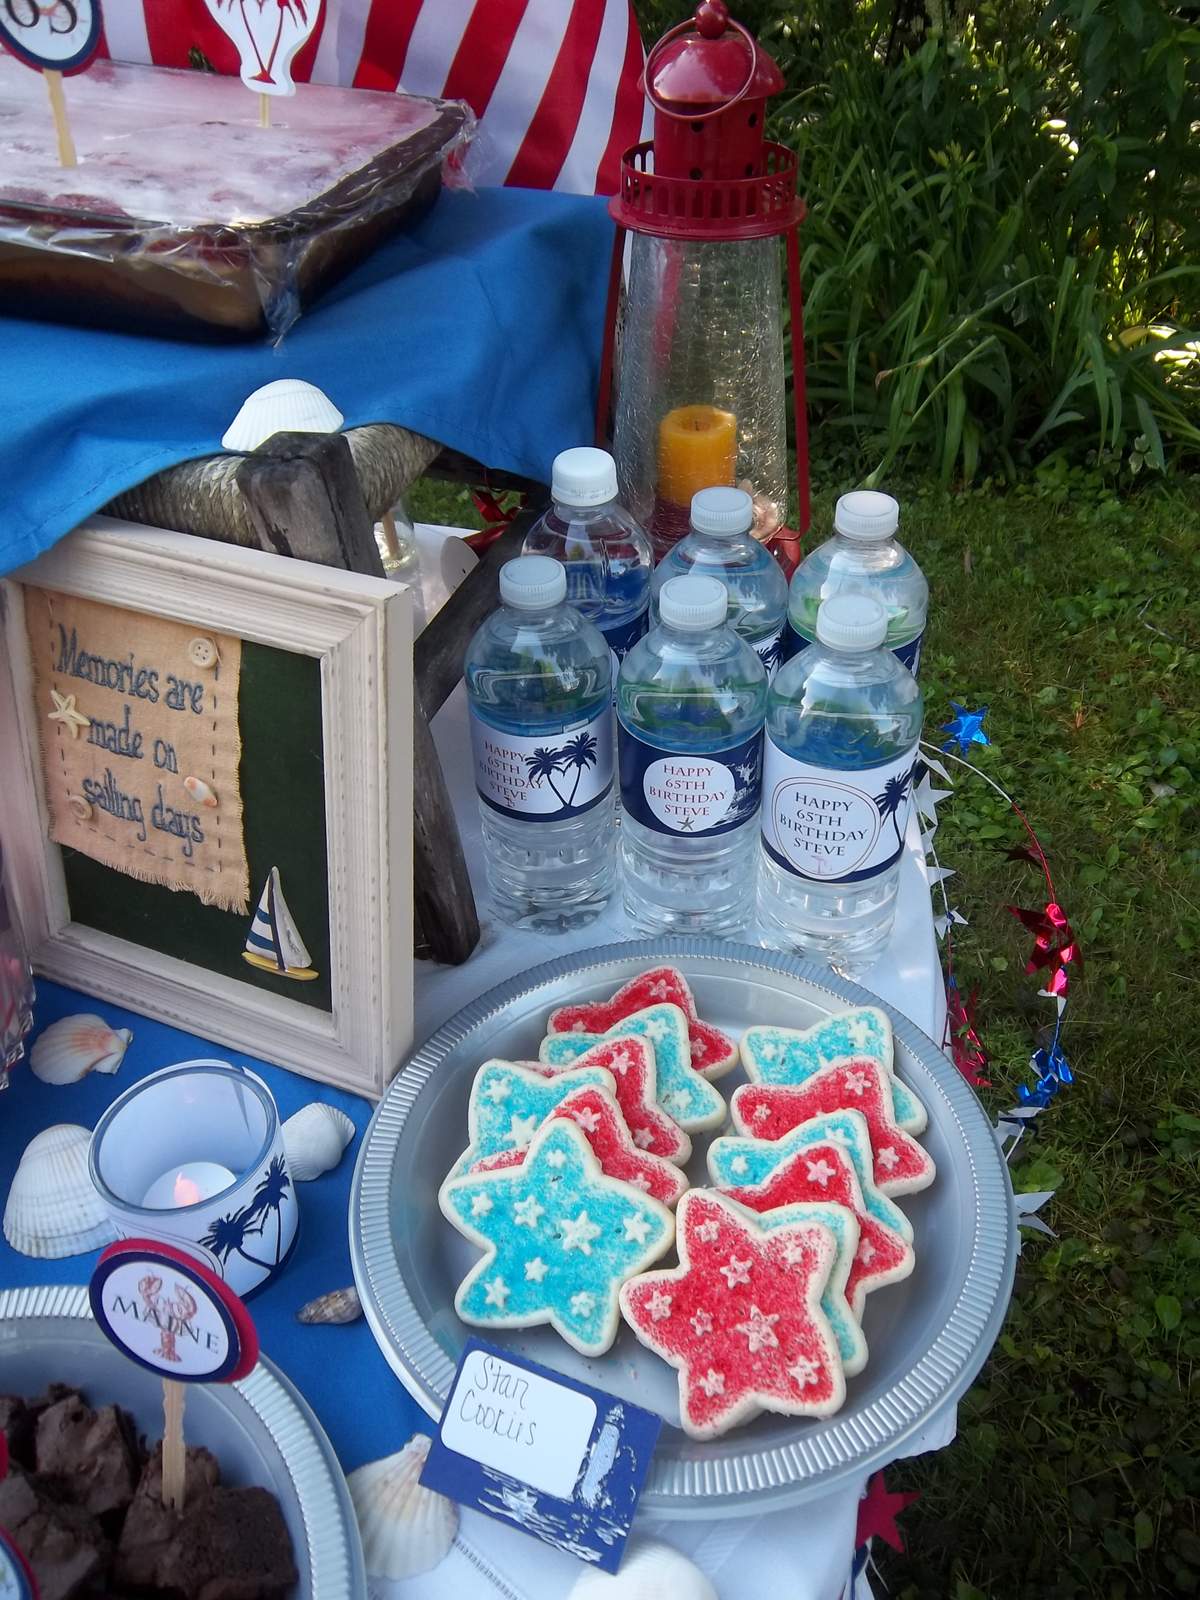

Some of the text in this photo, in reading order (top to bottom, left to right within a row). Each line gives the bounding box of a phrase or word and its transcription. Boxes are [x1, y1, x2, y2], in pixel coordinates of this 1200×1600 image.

[54, 622, 204, 715] Memories are
[86, 704, 178, 775] made on
[484, 740, 526, 762] HAPPY
[488, 756, 520, 775] 65TH
[663, 764, 714, 777] HAPPY
[490, 781, 527, 801] STEVE
[665, 779, 705, 790] 65TH
[649, 786, 727, 804] BIRTHDAY
[795, 791, 853, 812] HAPPY
[82, 767, 204, 857] sailing days
[664, 804, 710, 816] STEVE
[796, 809, 842, 827] 65TH
[780, 813, 868, 842] BIRTHDAY
[793, 837, 845, 857] STEVE
[112, 1296, 220, 1355] MAINE
